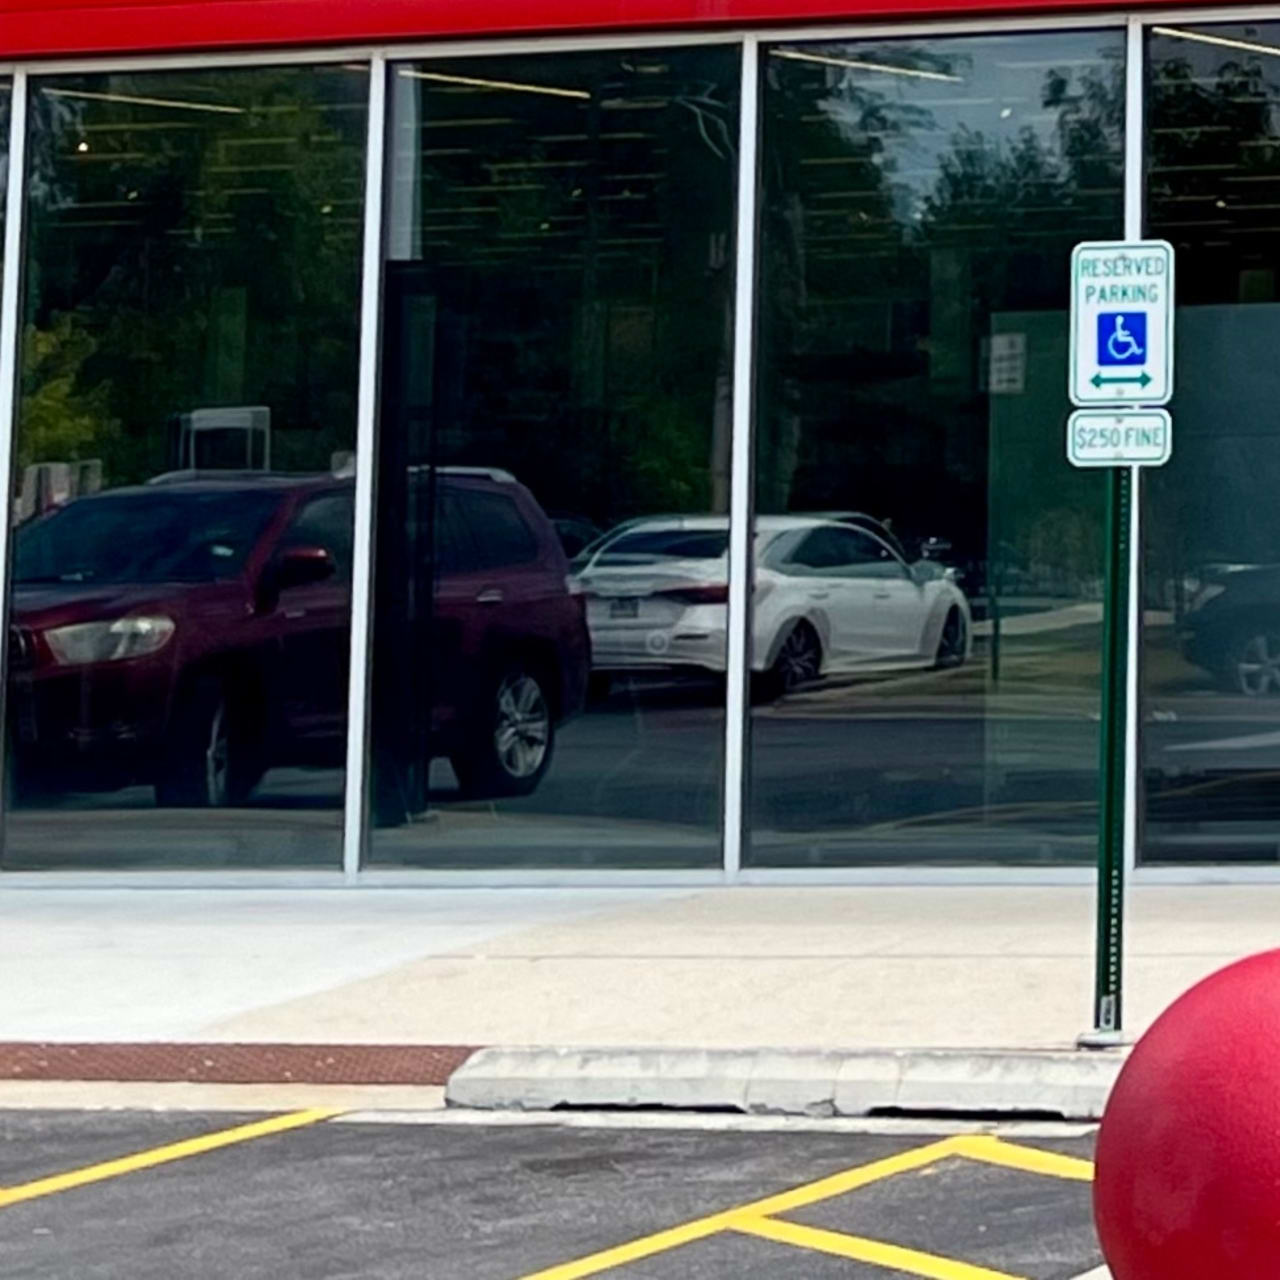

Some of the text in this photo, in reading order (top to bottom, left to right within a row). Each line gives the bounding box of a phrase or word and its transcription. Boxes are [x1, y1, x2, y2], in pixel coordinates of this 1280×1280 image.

[1080, 257, 1165, 277] RESERVED
[1085, 284, 1158, 304] PARKING
[1077, 427, 1162, 449] $250 FINE
